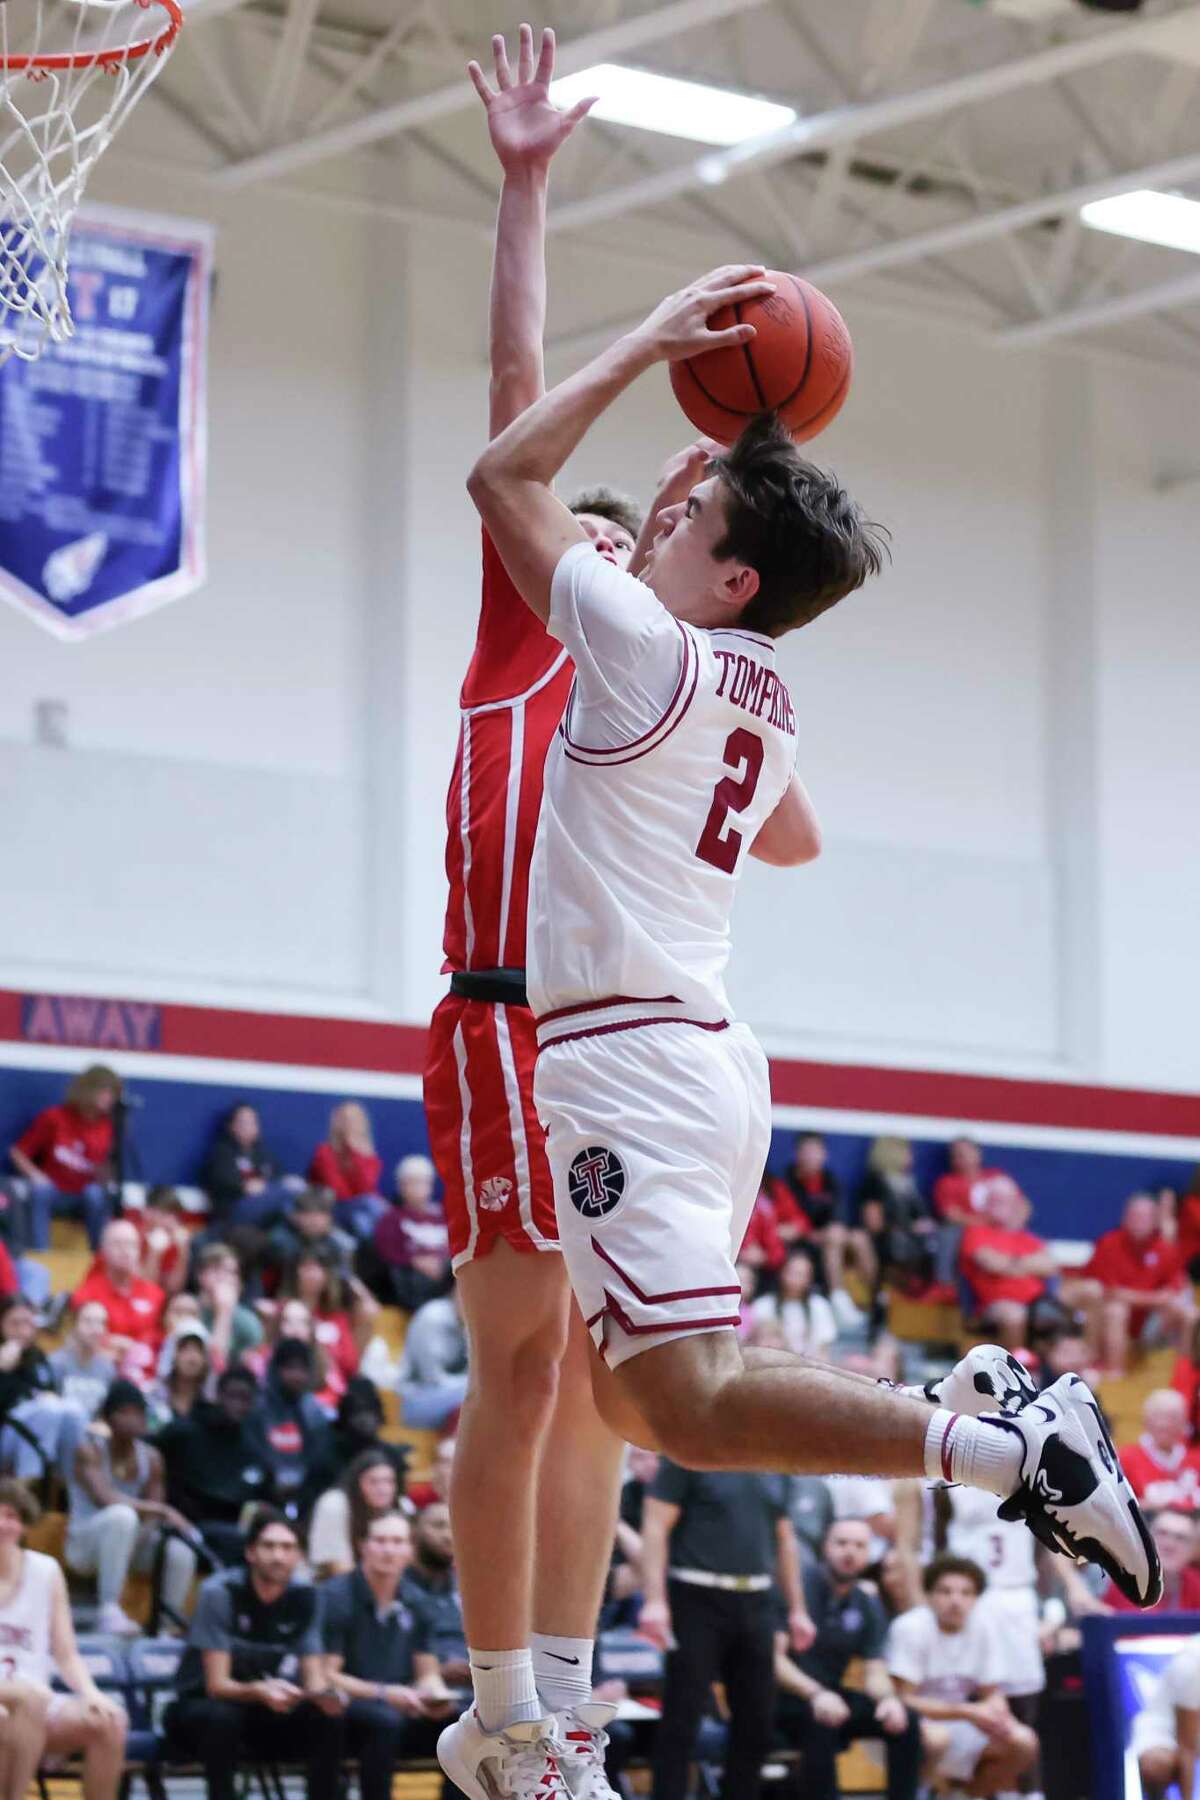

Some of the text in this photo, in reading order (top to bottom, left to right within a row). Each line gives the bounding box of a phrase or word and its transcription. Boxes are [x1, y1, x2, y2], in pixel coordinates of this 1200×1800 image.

[713, 650, 796, 736] TOMPKINS
[695, 727, 765, 875] 2
[24, 992, 162, 1050] AWAY
[574, 1152, 609, 1209] T
